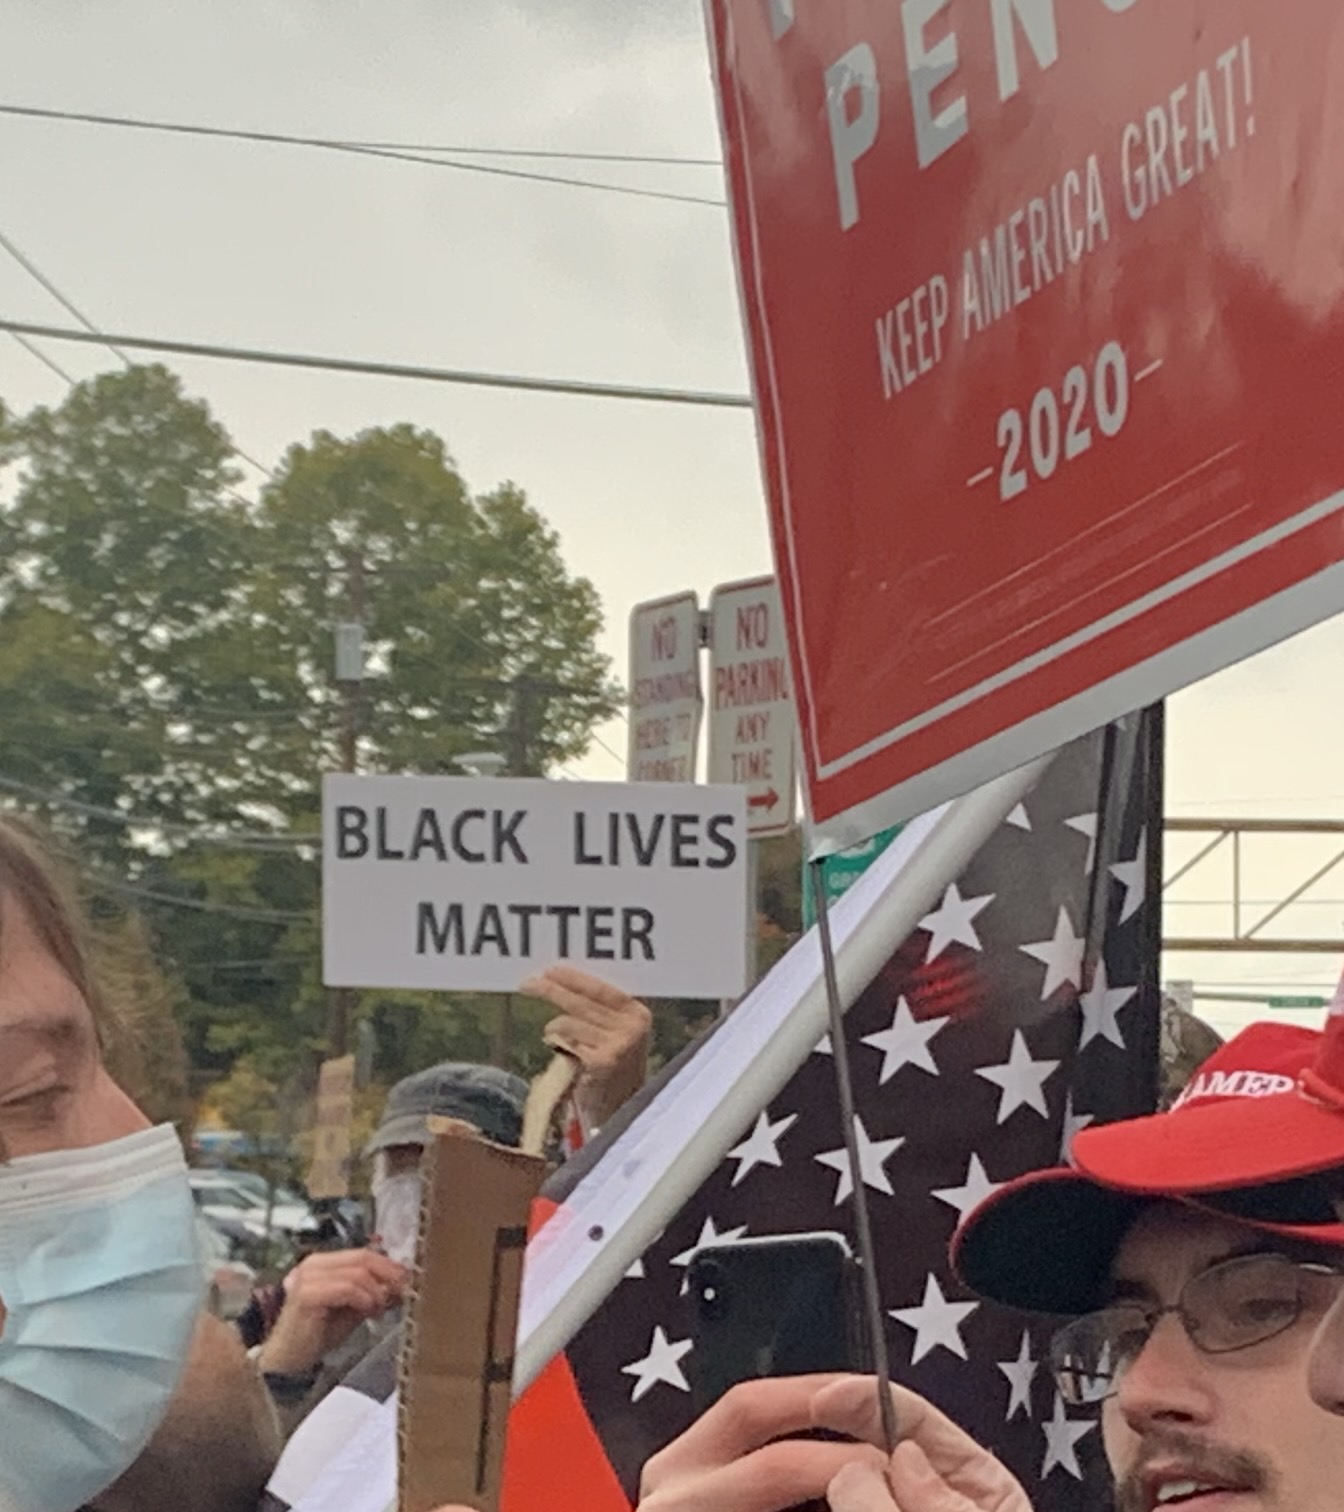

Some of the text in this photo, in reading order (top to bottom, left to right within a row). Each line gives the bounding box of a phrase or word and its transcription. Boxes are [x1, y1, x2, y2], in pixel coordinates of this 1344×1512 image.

[825, 0, 1145, 231] PEN
[875, 37, 1256, 399] KEEP AMERICA GREAT!
[737, 602, 768, 650] NO
[736, 711, 770, 744] ANY
[731, 748, 773, 784] TIME
[335, 805, 738, 869] BLACK LIVES
[415, 901, 657, 961] MATTER
